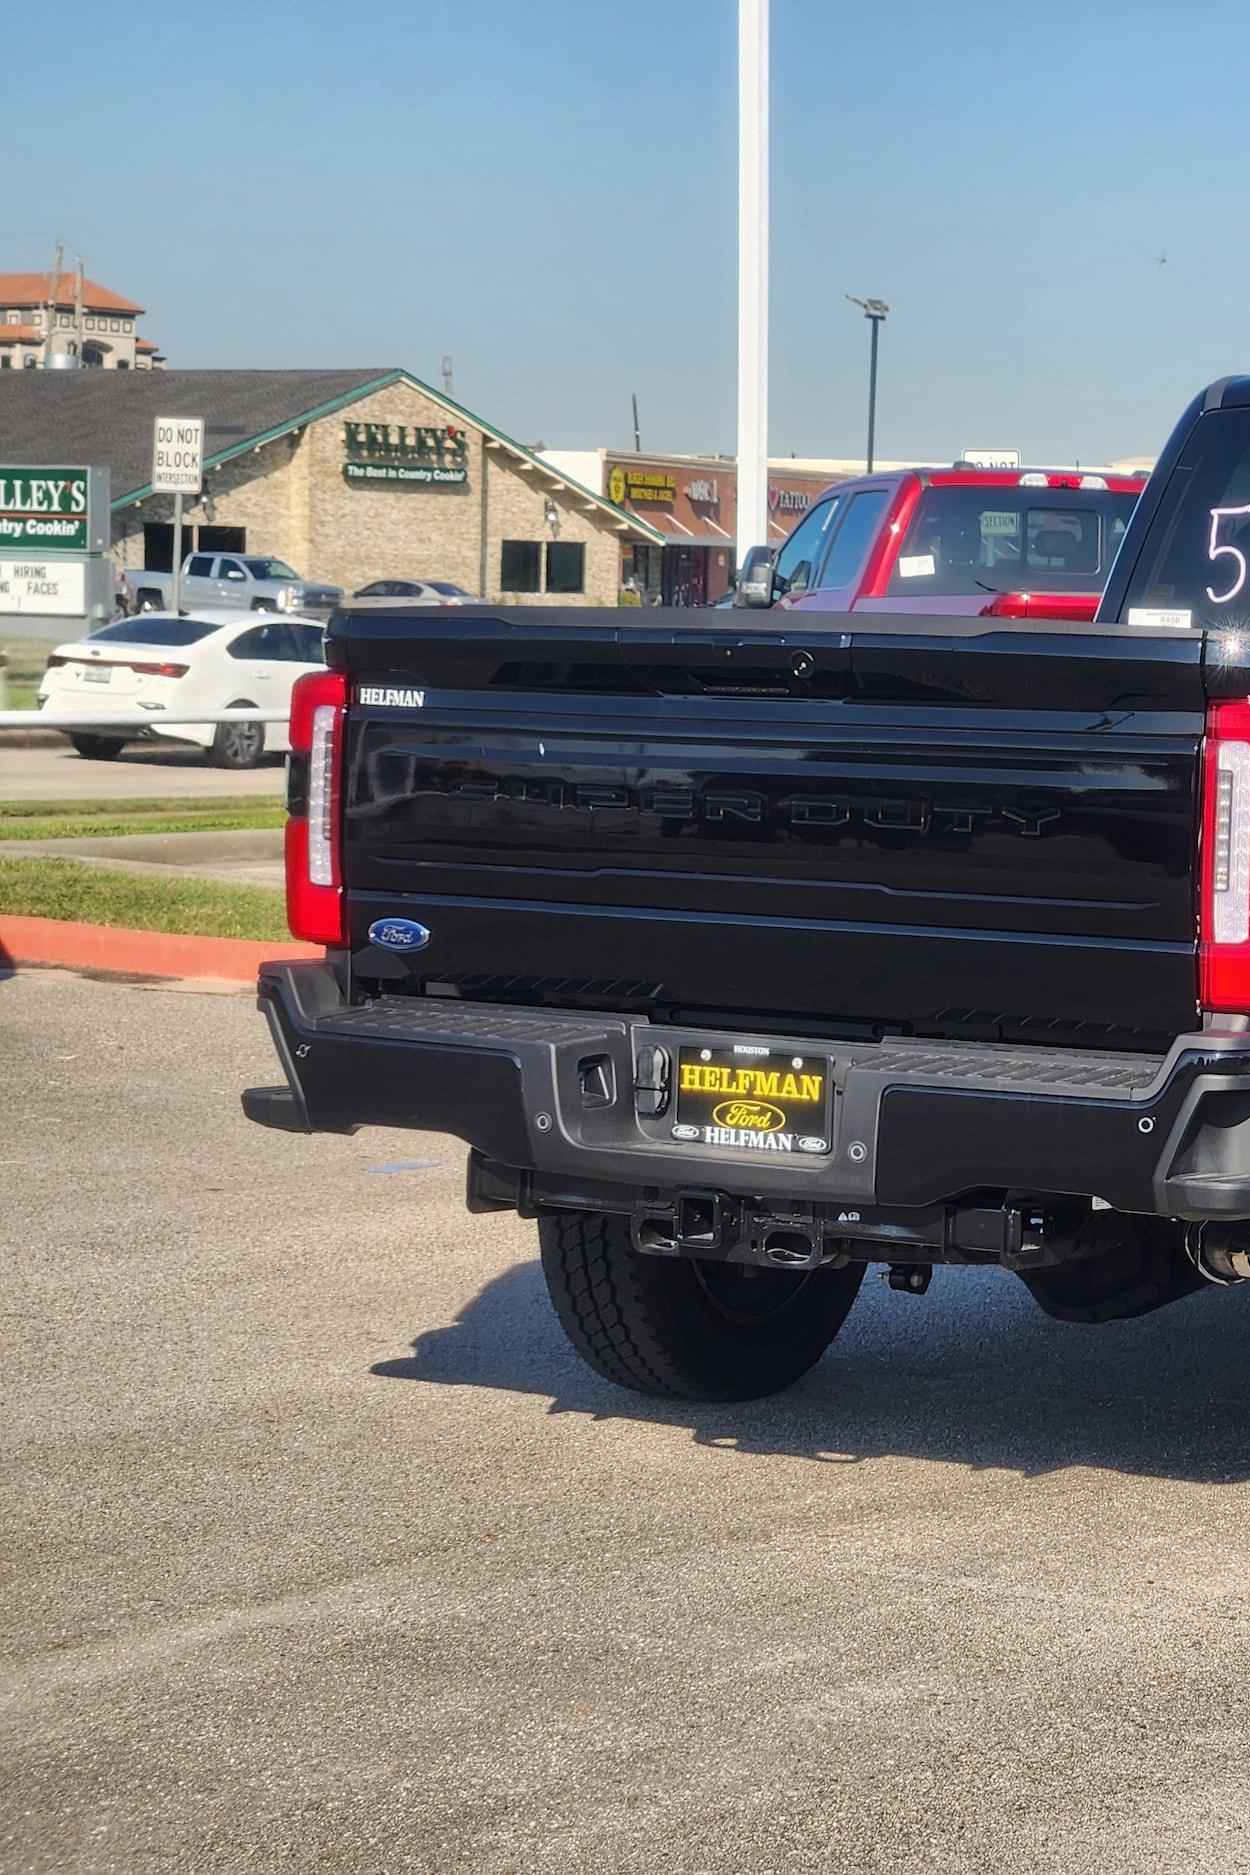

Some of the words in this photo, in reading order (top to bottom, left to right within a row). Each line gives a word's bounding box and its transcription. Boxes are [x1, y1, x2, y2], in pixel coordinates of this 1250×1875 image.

[158, 428, 173, 443] DO
[177, 428, 200, 444] NOT
[344, 421, 466, 457] KELLEY'S
[157, 451, 199, 469] BLOCK
[156, 472, 199, 485] INTERSECTION
[347, 465, 365, 477] The
[366, 466, 387, 478] Best
[388, 468, 397, 478] in
[398, 468, 432, 482] Country
[25, 519, 80, 536] Cookin'
[13, 565, 47, 579] HIRING
[27, 581, 59, 596] FACES
[360, 687, 425, 708] HELFMAN
[781, 795, 1062, 836] DUTY
[381, 924, 414, 943] Ford
[733, 1044, 770, 1056] HOUSTON
[680, 1064, 823, 1101] HELFMAN
[725, 1103, 773, 1128] Ford
[704, 1125, 793, 1151] HELFMAN
